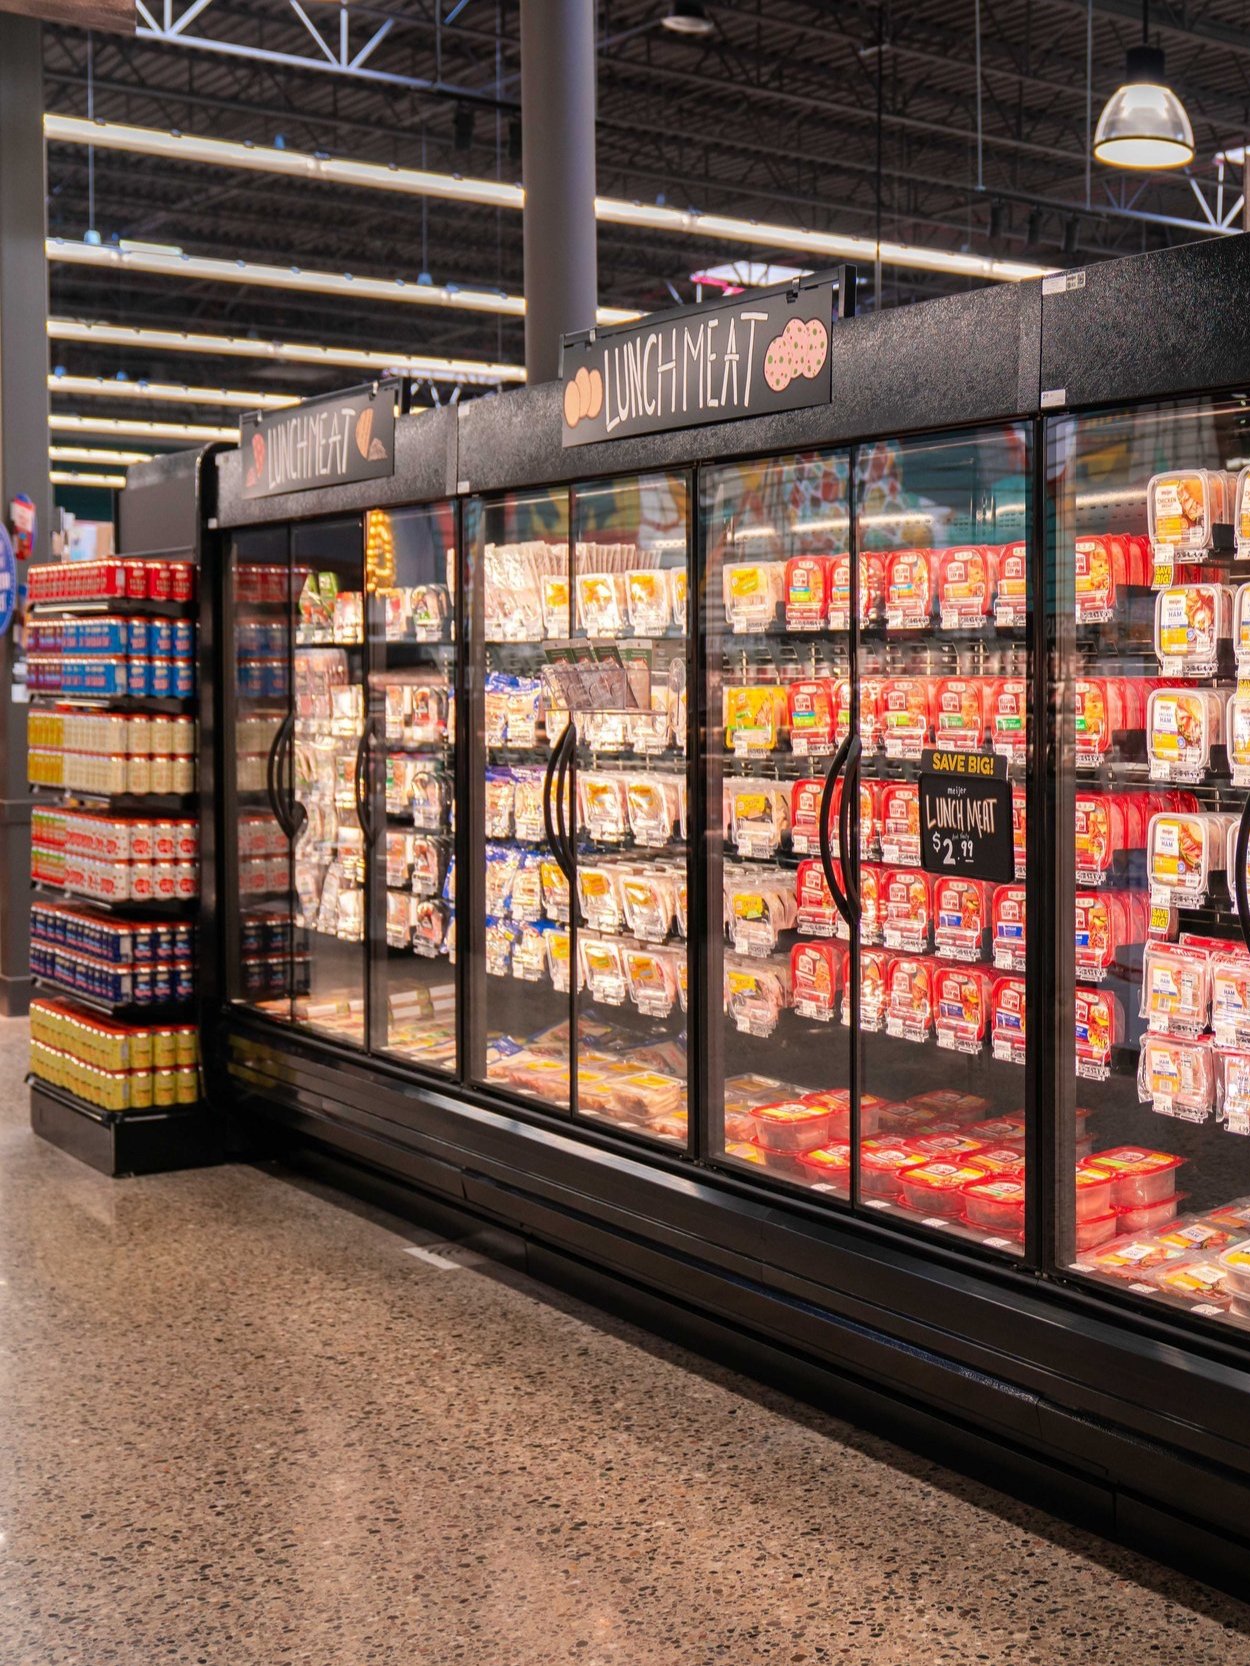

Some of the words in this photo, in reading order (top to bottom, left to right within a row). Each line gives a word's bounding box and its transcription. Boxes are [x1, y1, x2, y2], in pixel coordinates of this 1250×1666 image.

[1155, 565, 1171, 575] SAVE
[1155, 574, 1170, 584] BIG!
[1168, 610, 1182, 618] HAM
[933, 753, 965, 773] SAVE
[968, 756, 994, 775] BIG!
[947, 786, 967, 797] meijer
[926, 794, 964, 832] LUNCH
[967, 798, 998, 839] MEAT
[1161, 840, 1174, 848] HAM
[1151, 908, 1169, 917] SAVE
[1151, 916, 1168, 928] BIG!
